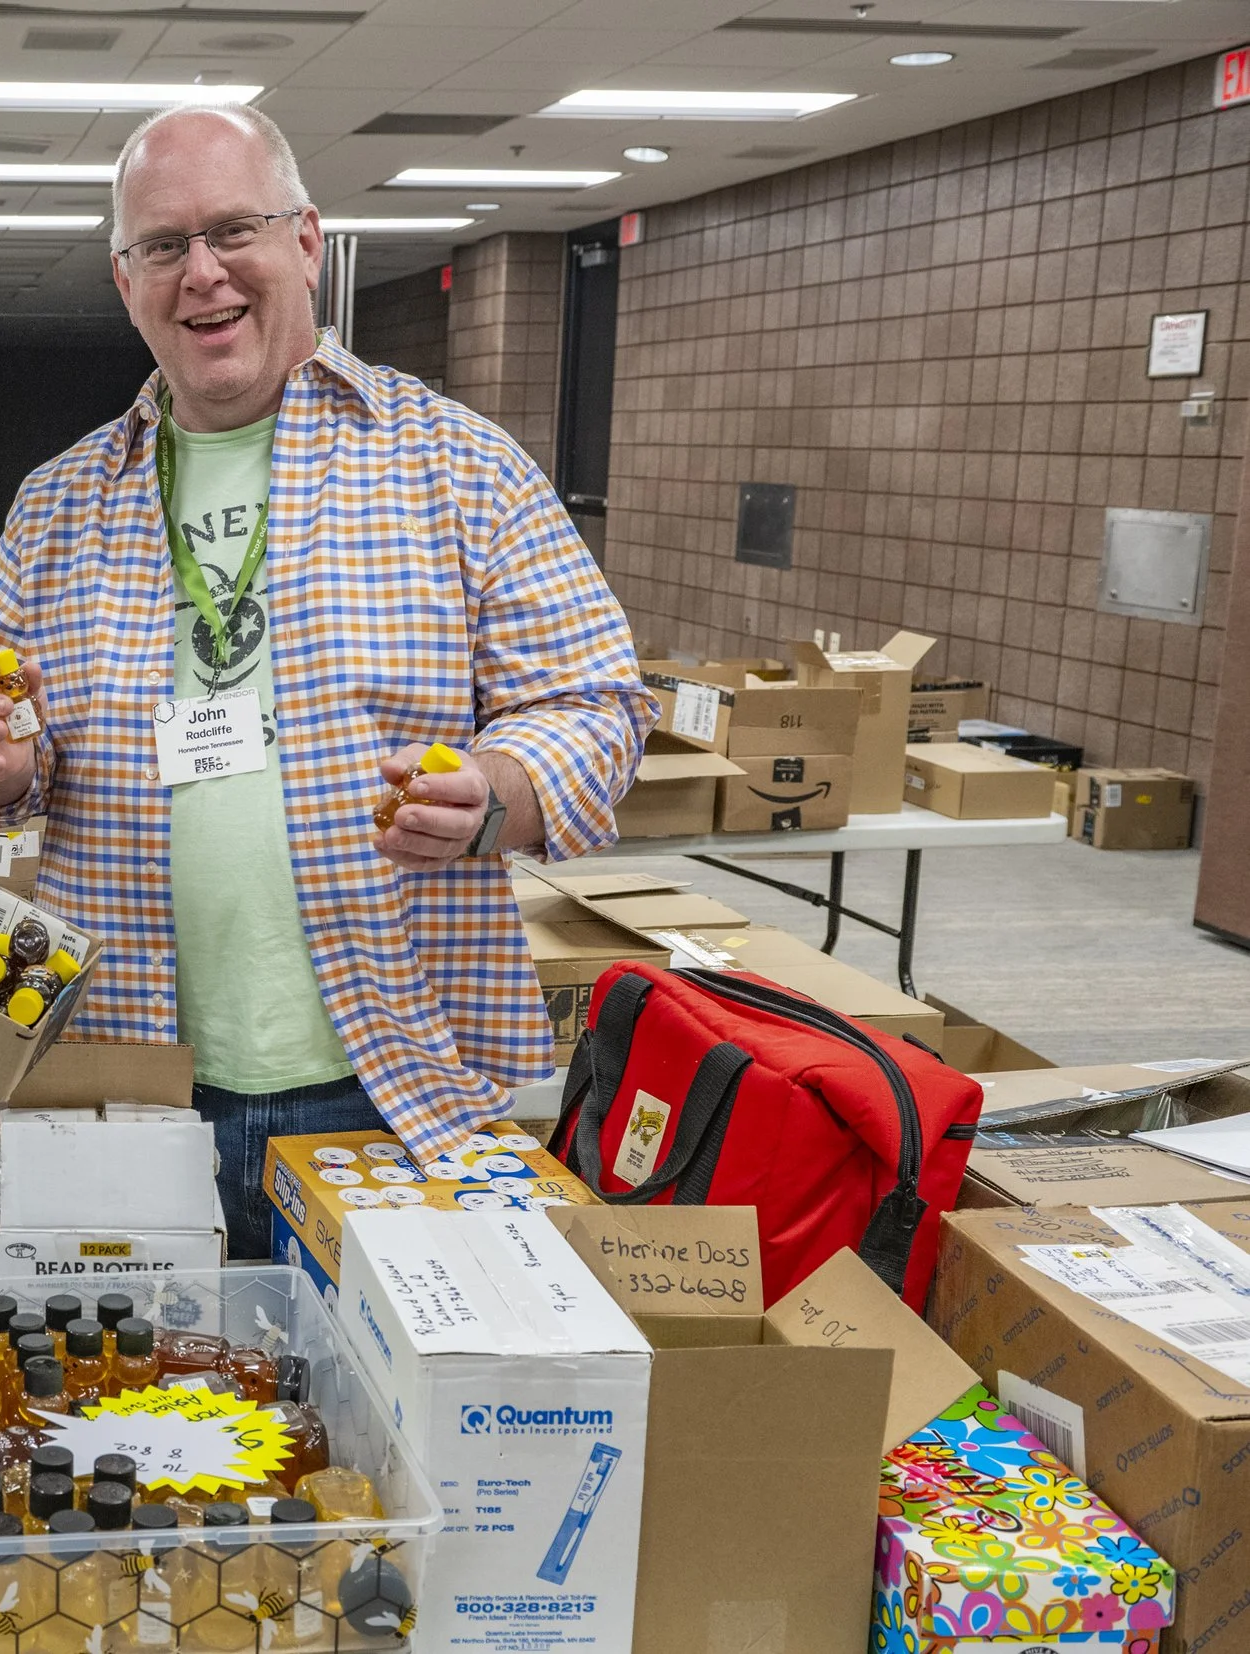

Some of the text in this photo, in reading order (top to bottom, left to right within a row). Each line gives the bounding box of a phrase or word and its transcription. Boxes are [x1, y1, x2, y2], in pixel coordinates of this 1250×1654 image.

[1222, 51, 1250, 100] EX
[216, 688, 256, 700] VENDOR
[188, 708, 226, 724] John
[186, 725, 233, 740] Radcliffe
[178, 739, 244, 754] Honeybee Tennessee
[194, 757, 215, 767] BEE
[195, 763, 224, 774] EXPO
[83, 1245, 126, 1255] 12 PACK
[600, 1236, 688, 1263] therine
[35, 1261, 176, 1280] BEAR BOTTLES
[496, 1404, 614, 1426] Quantum
[498, 1425, 613, 1436] Labs Incorporated
[477, 1479, 532, 1488] Euro-Tech
[476, 1488, 519, 1497] (Pro Series)
[476, 1506, 502, 1514] T185
